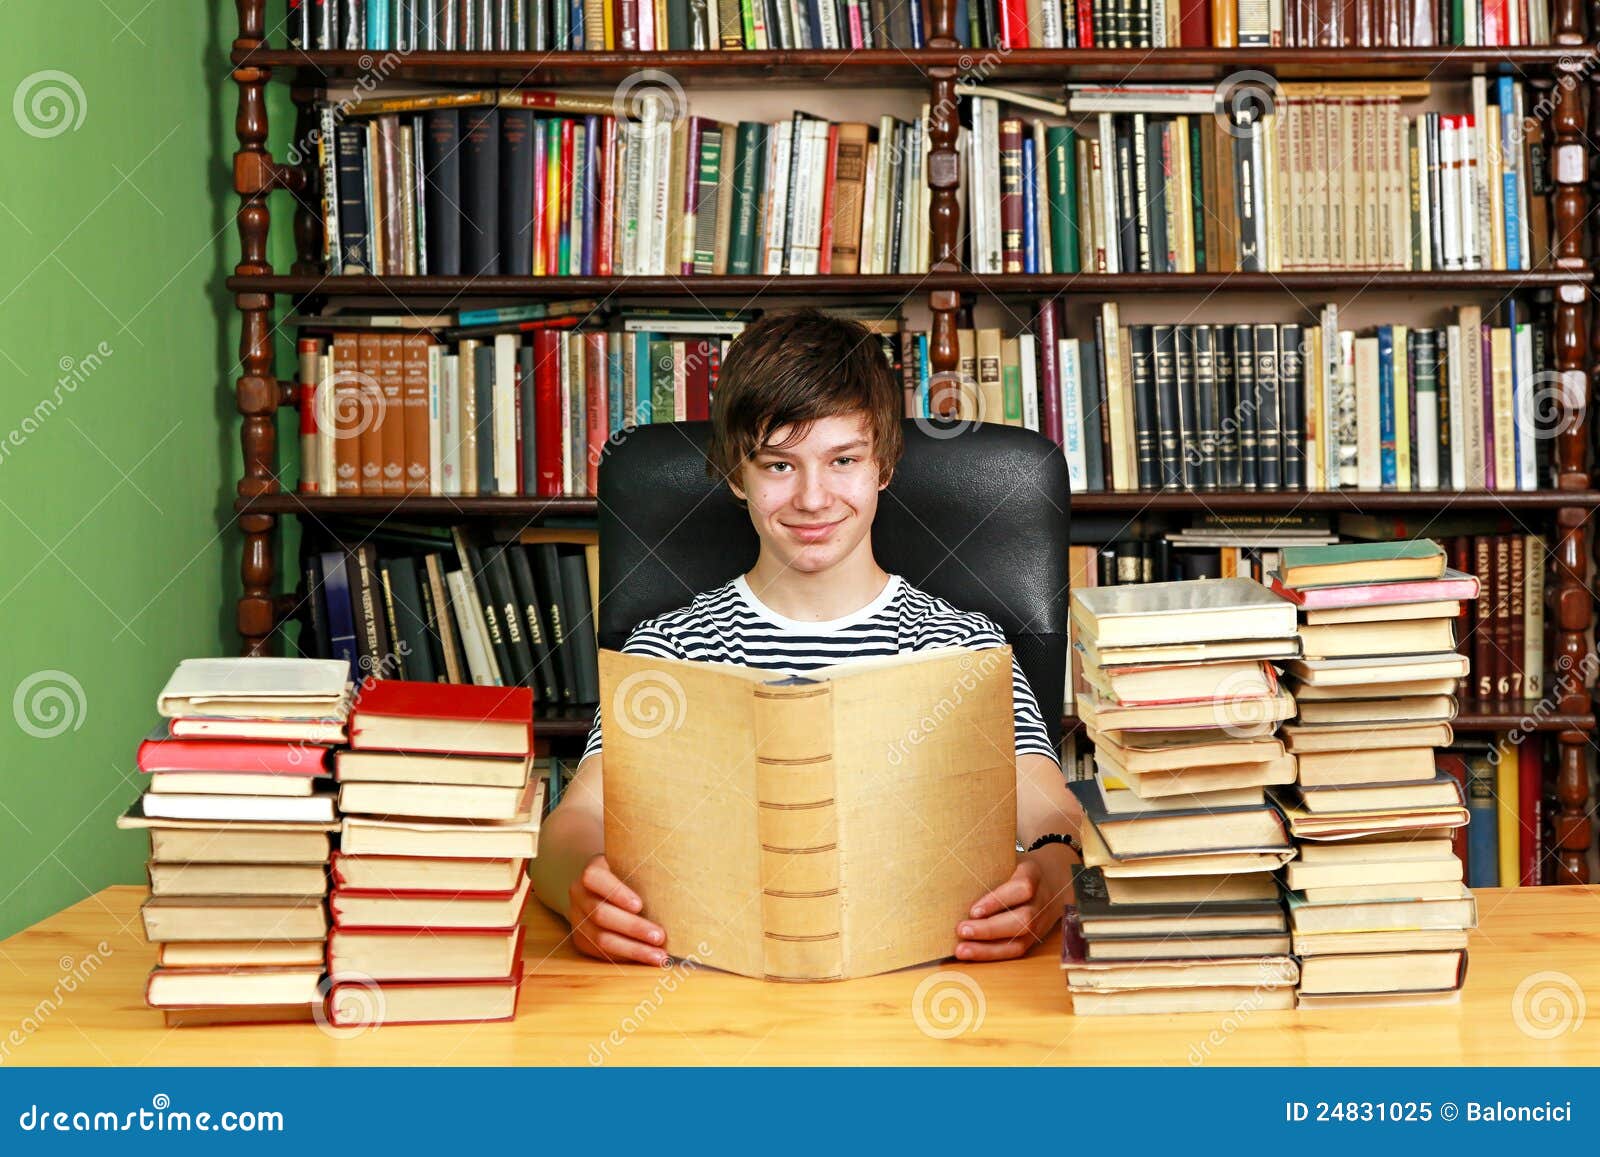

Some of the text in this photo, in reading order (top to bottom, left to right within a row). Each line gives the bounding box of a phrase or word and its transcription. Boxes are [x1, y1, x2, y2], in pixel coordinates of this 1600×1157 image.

[1480, 676, 1491, 695] 5
[1498, 676, 1509, 695] 6
[1511, 673, 1522, 692] 7
[1529, 675, 1539, 692] 8
